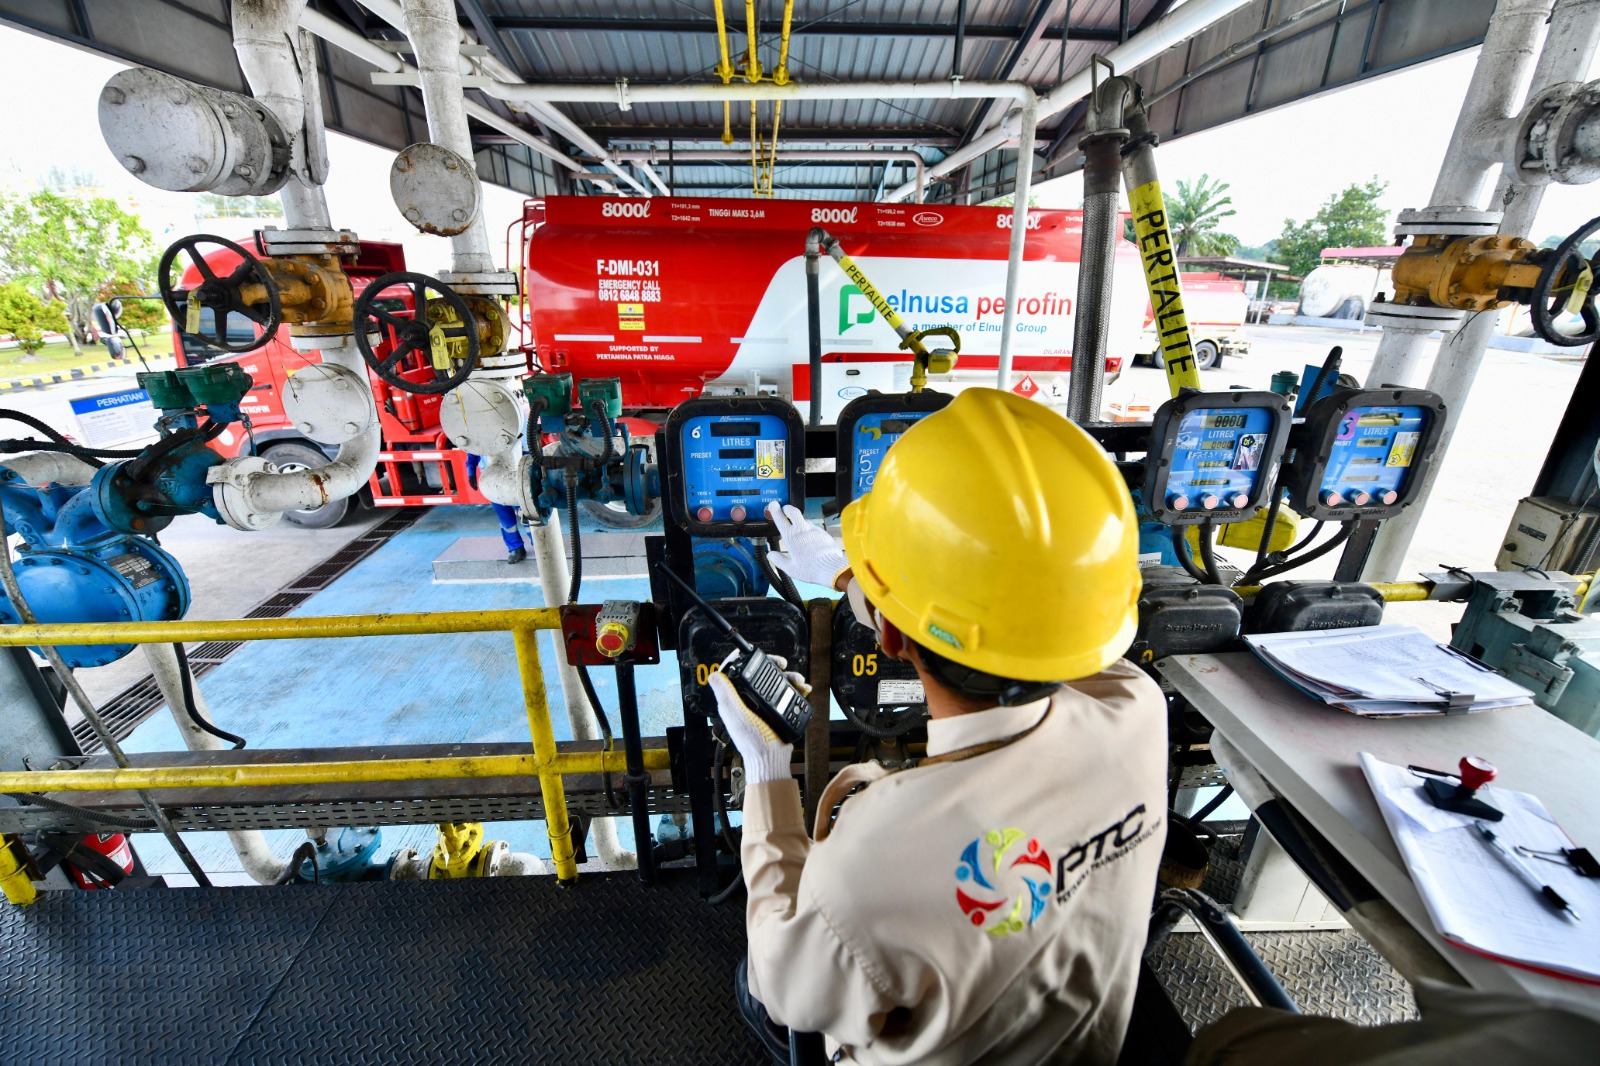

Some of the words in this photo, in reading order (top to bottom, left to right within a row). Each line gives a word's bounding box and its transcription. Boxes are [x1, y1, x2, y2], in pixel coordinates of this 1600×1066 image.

[709, 208, 731, 217] TINGGI
[732, 209, 749, 218] MAKS
[750, 210, 765, 219] 3,6M
[597, 259, 659, 276] F-DMI-031
[598, 279, 641, 290] EMERGENCY
[642, 280, 661, 290] CALL
[598, 289, 619, 301] 0812
[619, 289, 640, 301] 6848
[641, 290, 661, 302] 8883
[846, 264, 895, 321] PERTALITE
[1136, 209, 1197, 376] PERTALITE
[886, 289, 968, 314] elnusa
[976, 291, 1072, 320] perofin
[912, 324, 919, 332] a
[966, 322, 976, 332] of
[1016, 323, 1047, 334] Group
[96, 391, 144, 408] PERHATIAN!
[691, 425, 701, 439] 6
[1336, 411, 1360, 441] 3
[1363, 427, 1389, 436] LITRES
[1208, 430, 1234, 439] LITRES
[722, 438, 751, 447] LITRES
[852, 653, 878, 676] 05
[1056, 803, 1146, 894] PTC
